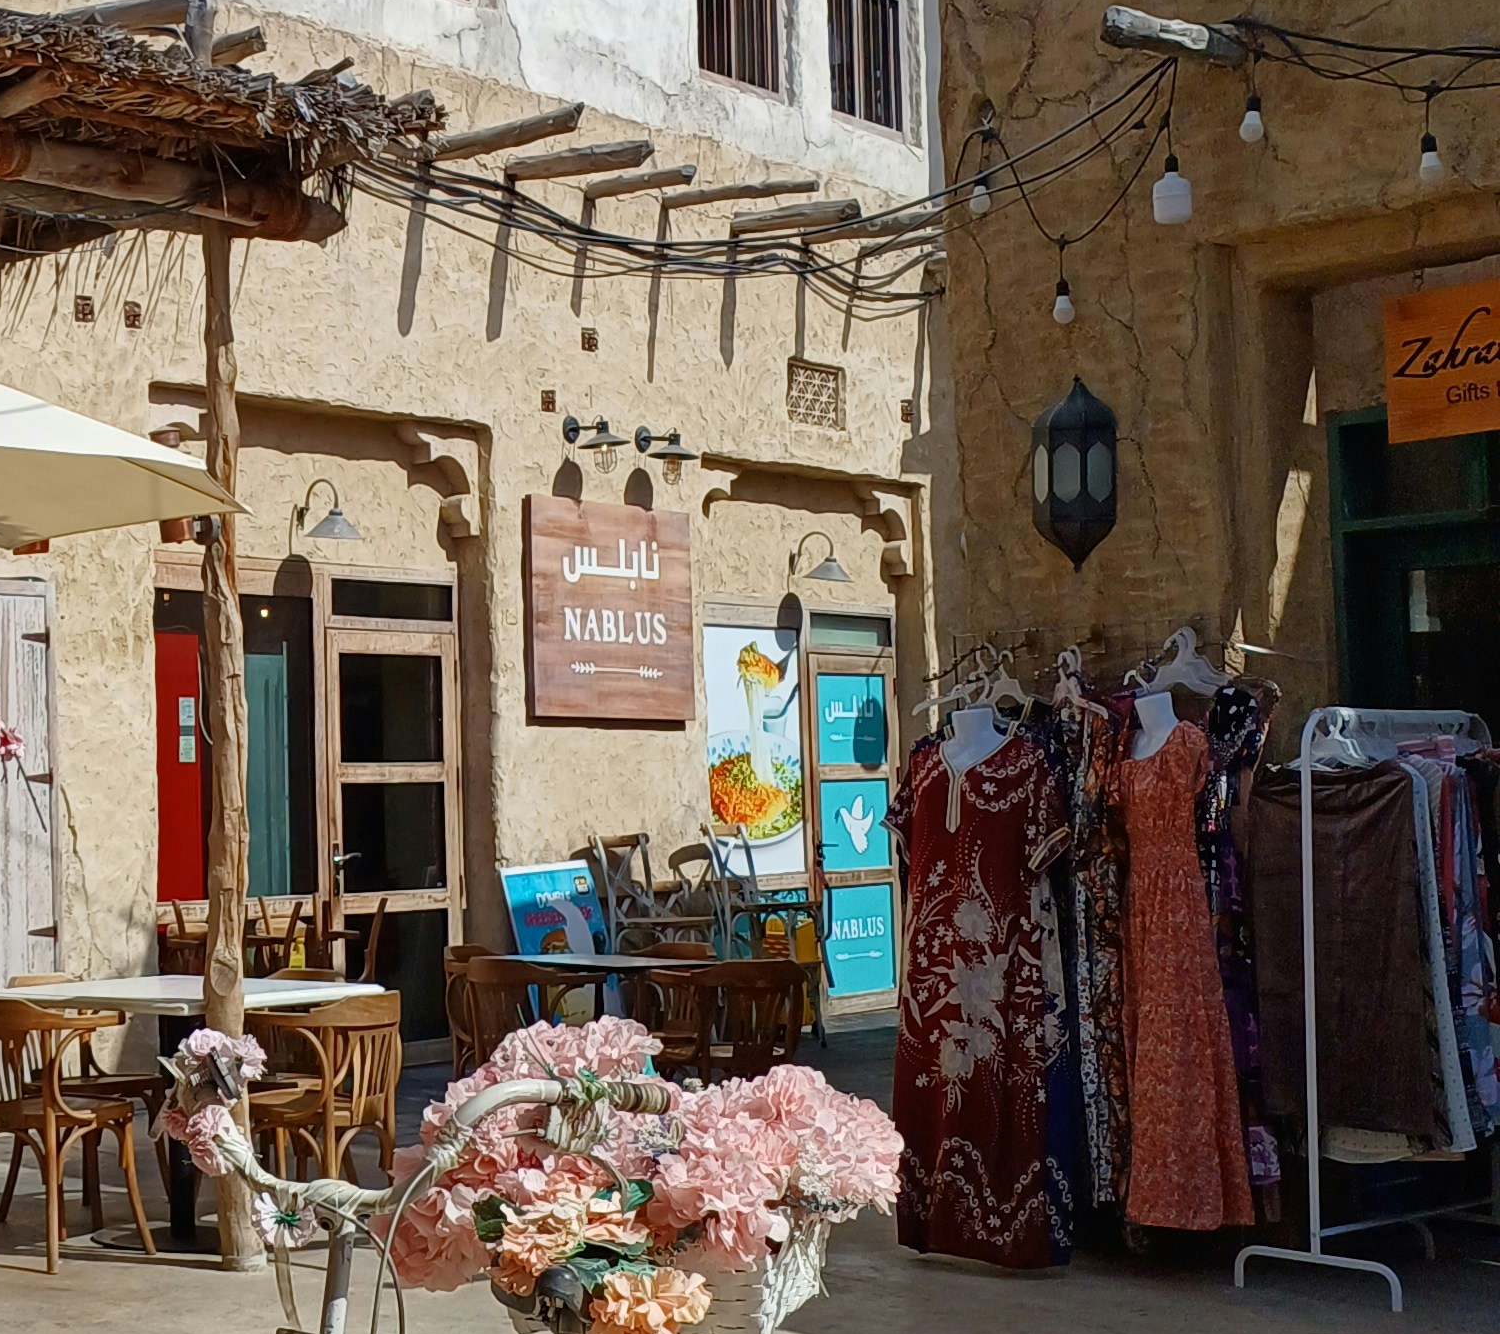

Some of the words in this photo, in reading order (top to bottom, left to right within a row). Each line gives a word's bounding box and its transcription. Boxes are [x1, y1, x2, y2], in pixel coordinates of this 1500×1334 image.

[1393, 306, 1500, 379] Zahra
[1446, 382, 1490, 404] Gifts
[562, 538, 660, 590] نابلس
[563, 607, 667, 645] NABLUS
[831, 916, 885, 941] NABLUS
